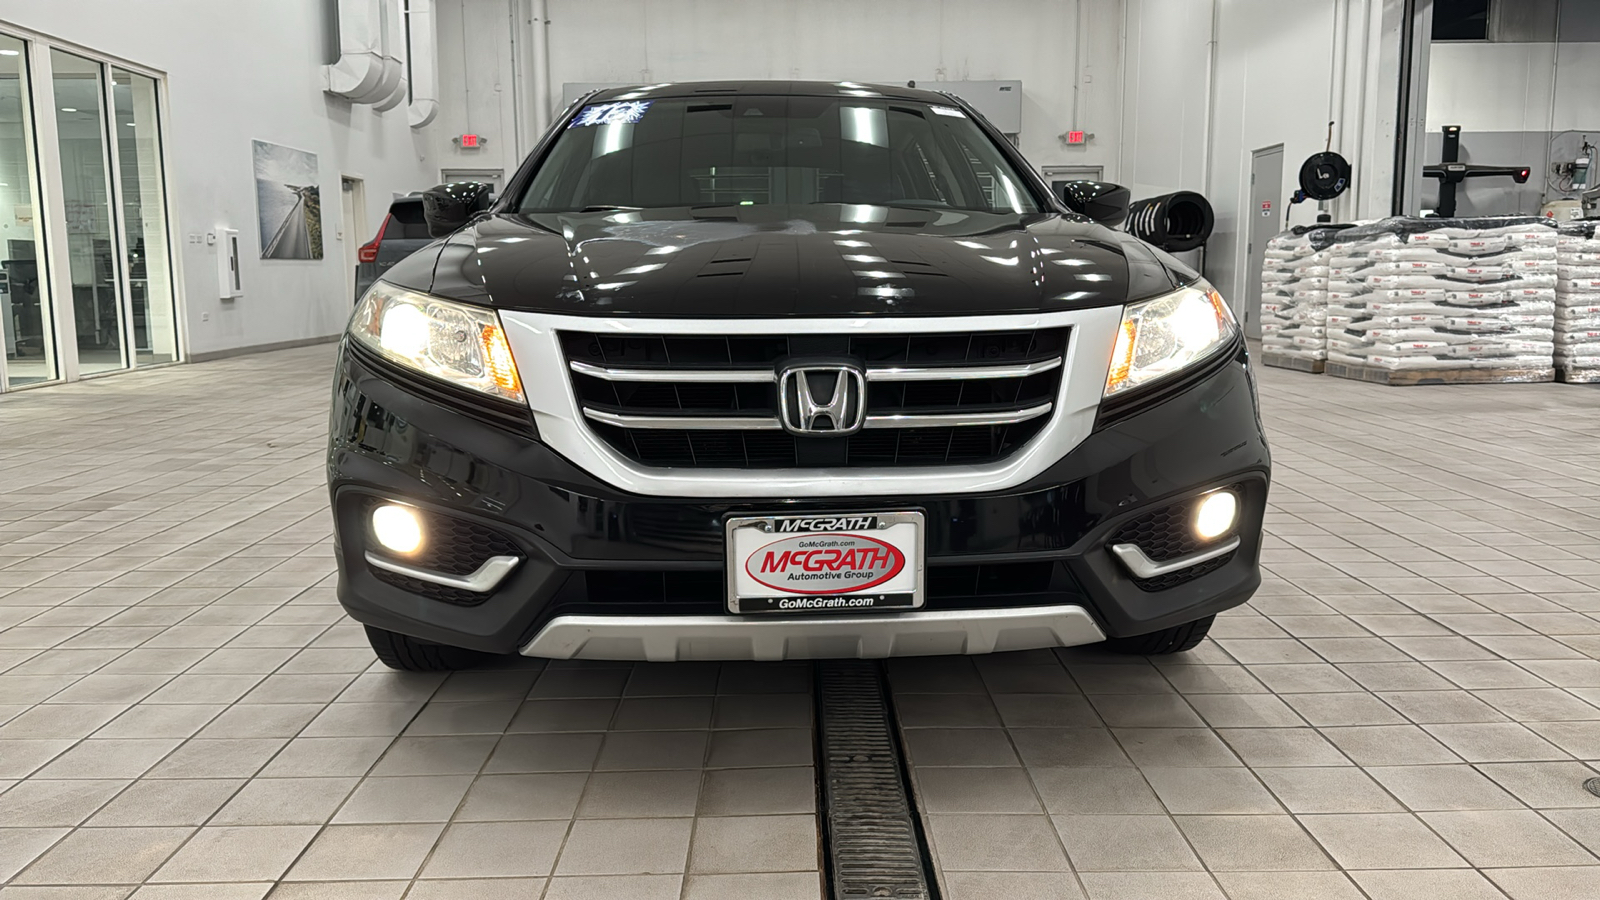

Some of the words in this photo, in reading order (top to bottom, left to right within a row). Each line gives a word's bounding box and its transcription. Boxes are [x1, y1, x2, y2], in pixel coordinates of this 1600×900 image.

[798, 540, 856, 549] GoMcGrath.com
[760, 547, 892, 573] McGRATH
[787, 571, 842, 581] Automotive
[844, 570, 874, 580] Group
[779, 597, 874, 609] GoMcGrath.com
